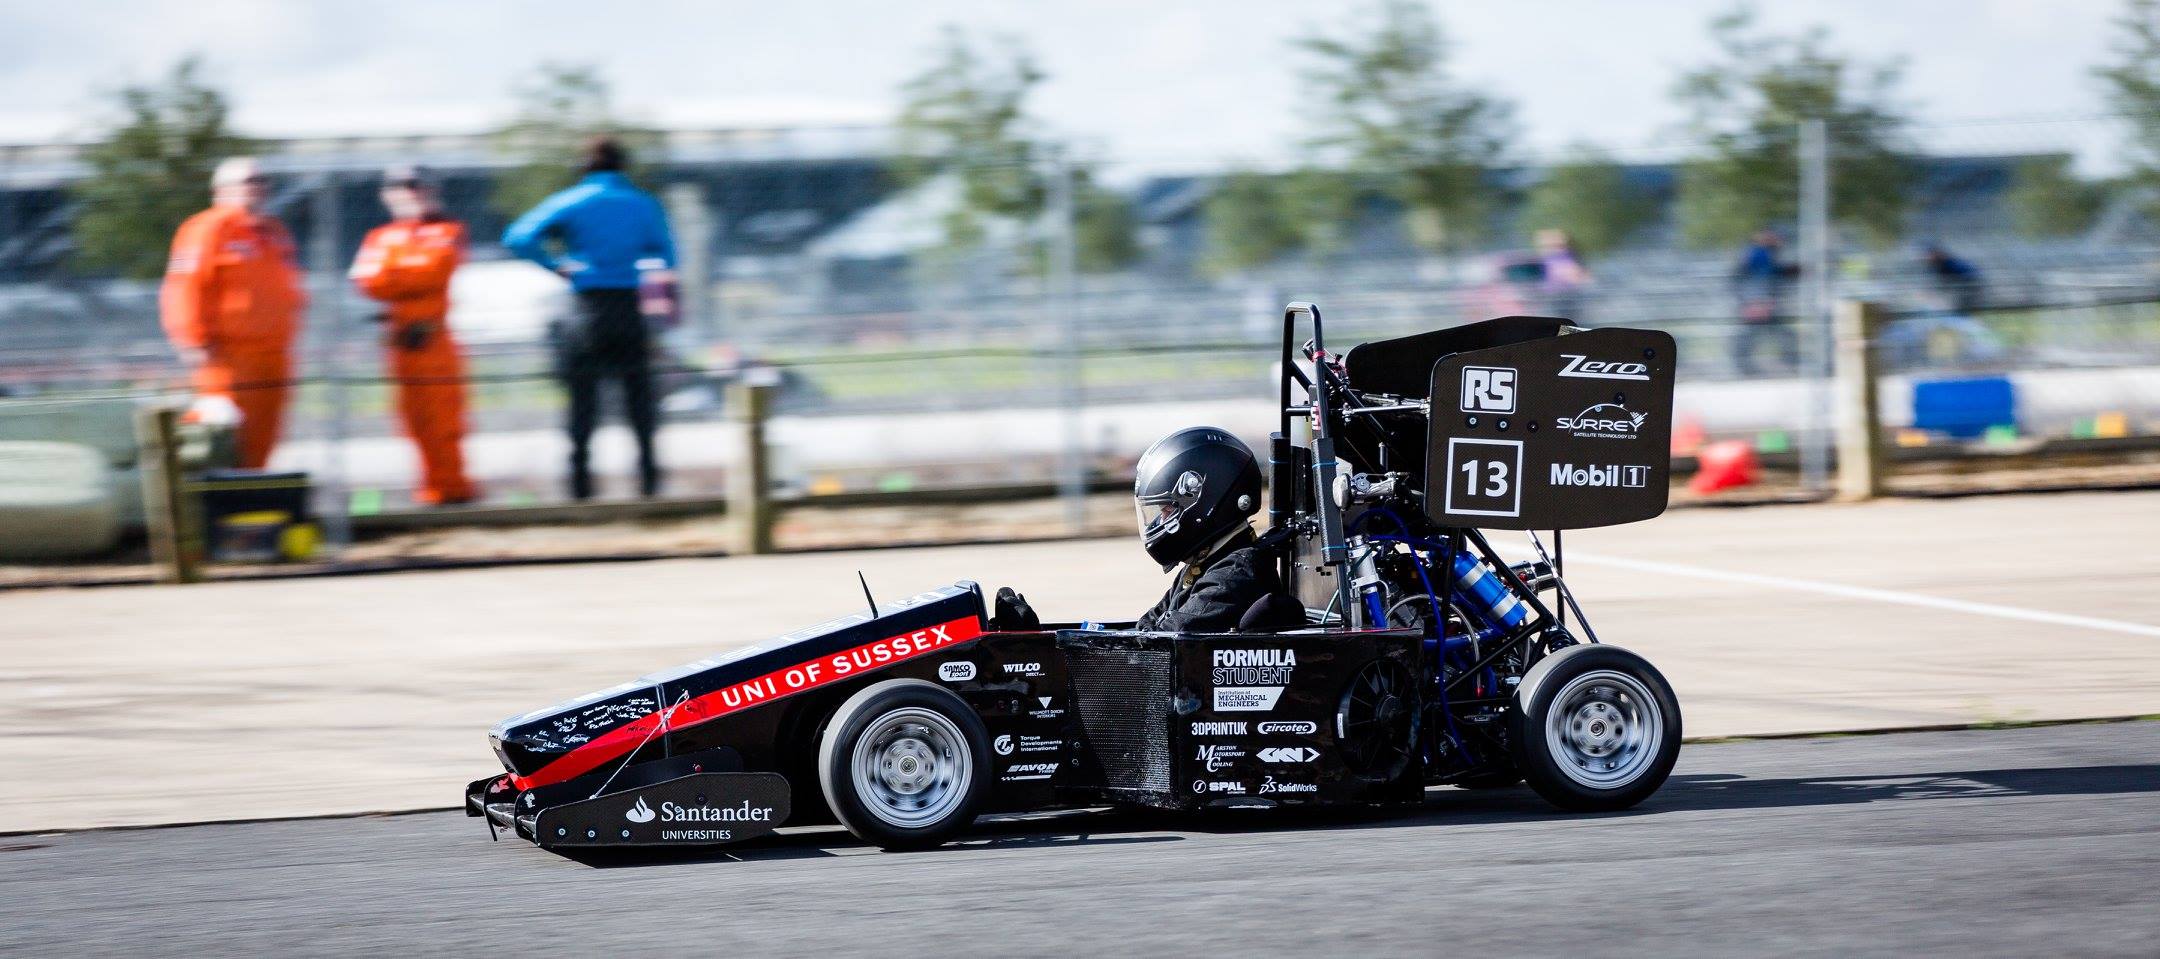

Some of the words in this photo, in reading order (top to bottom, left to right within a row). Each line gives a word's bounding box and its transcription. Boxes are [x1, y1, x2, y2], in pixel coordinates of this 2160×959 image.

[1558, 355, 1649, 380] Zero
[1464, 369, 1514, 409] RS
[1556, 418, 1645, 432] SURREY
[1461, 460, 1508, 497] 13
[1550, 463, 1618, 487] Mobil
[721, 679, 777, 707] UNI
[785, 663, 822, 688] OF
[832, 624, 953, 674] SUSSEX
[1213, 649, 1296, 667] FORMULA
[1003, 663, 1040, 673] WILCO
[1212, 667, 1293, 685] STUDENT
[1191, 722, 1248, 736] 3DPRINTUK
[1265, 723, 1309, 732] zircotec
[1018, 763, 1059, 772] AVON
[1209, 781, 1246, 792] SPAL
[1278, 782, 1317, 792] SolidWorks
[661, 800, 773, 822] Santander
[662, 830, 731, 840] UNIVERSITIES
